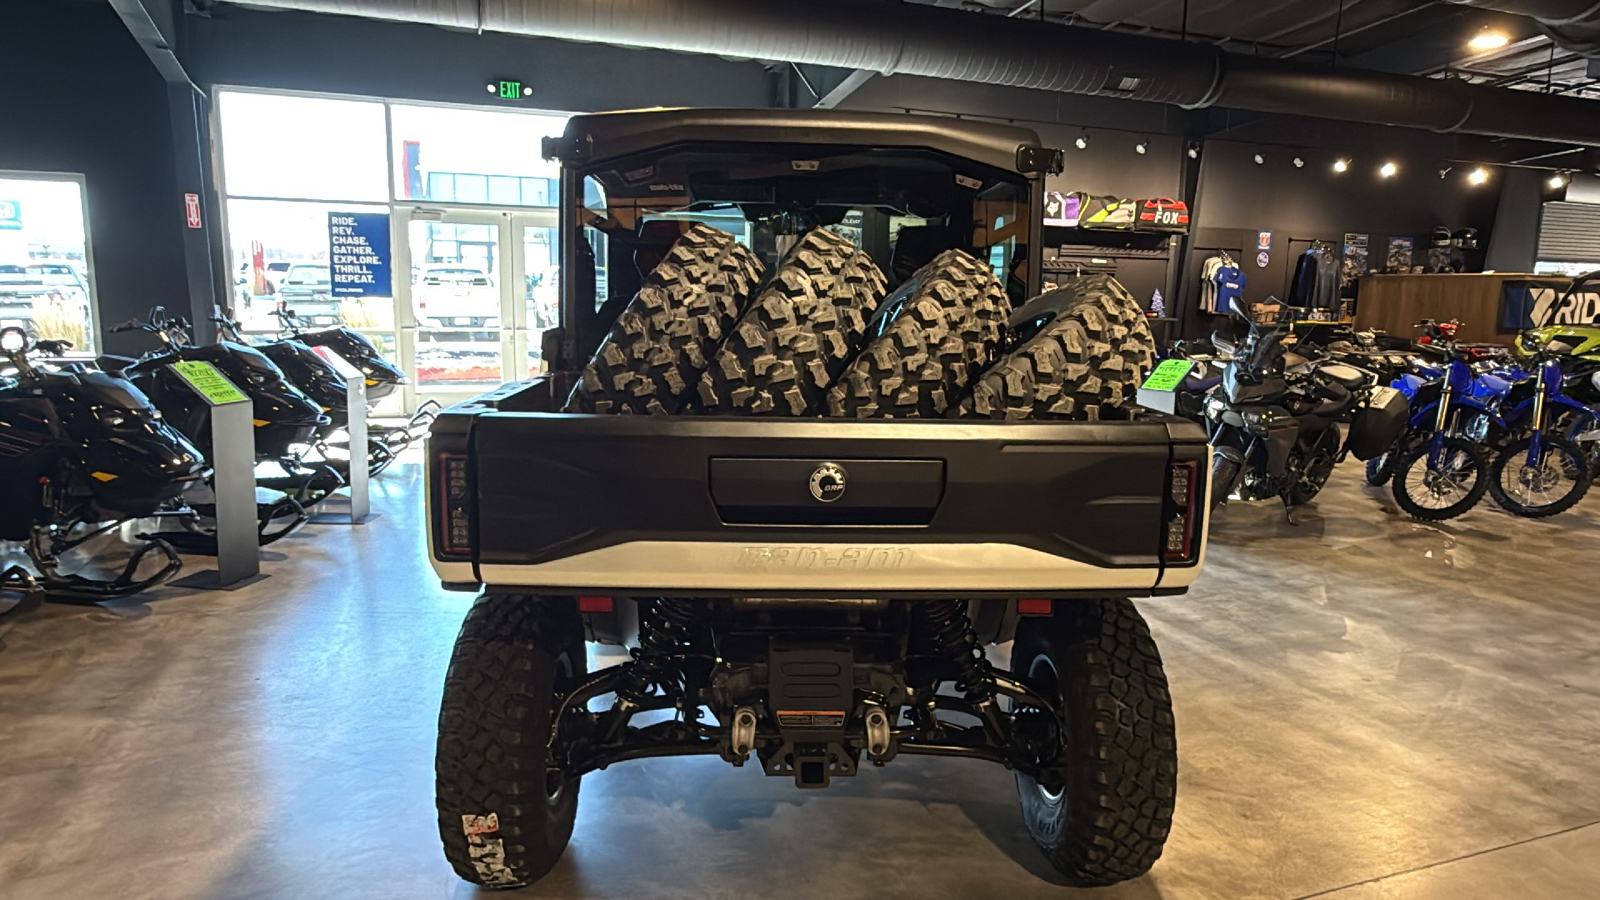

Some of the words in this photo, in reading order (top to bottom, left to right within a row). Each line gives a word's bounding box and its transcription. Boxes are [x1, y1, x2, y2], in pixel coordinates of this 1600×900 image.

[500, 81, 520, 98] EXIT
[332, 216, 358, 226] RIDE.
[1154, 211, 1178, 224] FOX
[332, 226, 355, 235] REV.
[332, 236, 369, 246] CHASE.
[333, 246, 376, 255] GATHER.
[334, 255, 382, 264] EXPLORE.
[334, 265, 372, 274] THRILL.
[334, 274, 376, 284] REPEAT.
[824, 484, 844, 492] BRP
